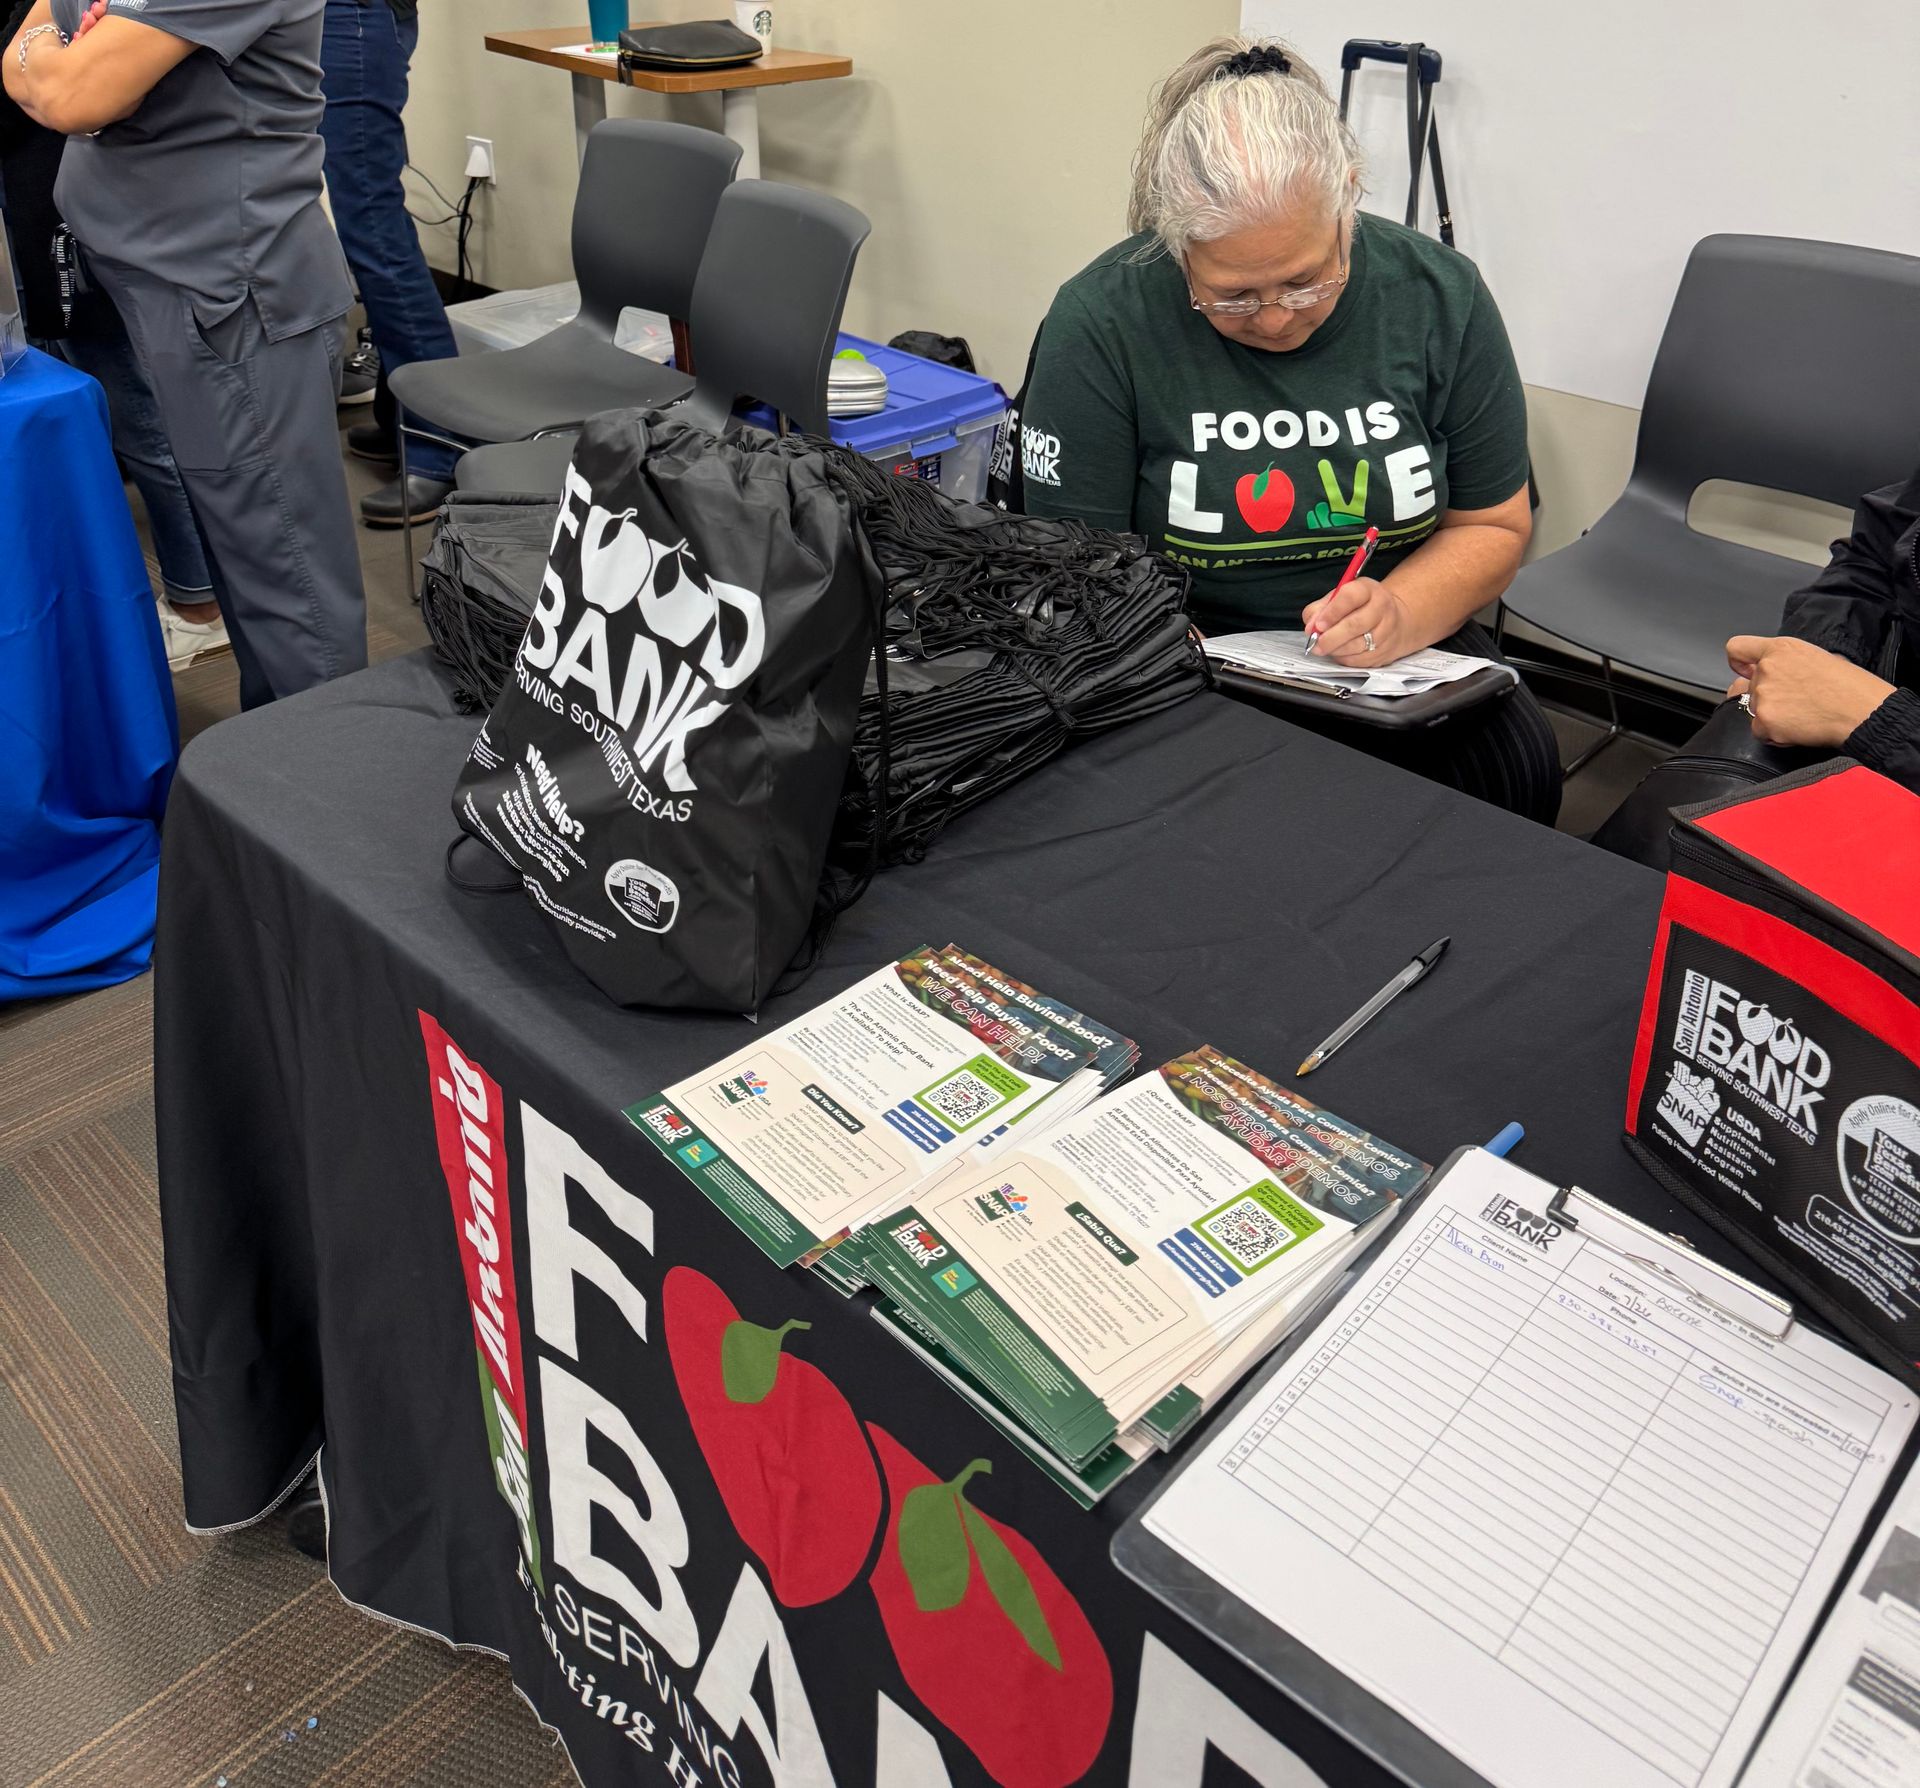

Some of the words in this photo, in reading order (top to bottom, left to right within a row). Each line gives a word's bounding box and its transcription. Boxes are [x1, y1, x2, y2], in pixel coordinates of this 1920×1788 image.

[1191, 409, 1340, 452] FOOD
[1344, 401, 1400, 446] IS
[1168, 444, 1436, 534] LOVE
[549, 461, 766, 690] FOOD
[1165, 550, 1208, 569] SAN
[520, 560, 733, 793] BANK
[570, 703, 634, 789] SOUTHWEST
[627, 775, 693, 822] TEXAS
[526, 743, 558, 795] Need
[542, 784, 585, 842] Help?
[547, 899, 579, 919] Nutrition
[579, 915, 617, 939] Assistance
[575, 922, 607, 943] provider.
[883, 982, 901, 998] What
[900, 995, 907, 1003] Is
[906, 1001, 931, 1019] SNAP?
[920, 976, 957, 1003] WE
[951, 999, 994, 1029] CAN
[987, 1024, 1047, 1064] HELP!
[923, 959, 960, 985] Need
[955, 981, 987, 1004] Help
[984, 1001, 1033, 1036] Buying
[1031, 1032, 1077, 1061] Food?
[948, 955, 986, 978] Need
[1066, 1020, 1114, 1049] Food?
[1681, 973, 1706, 1028] Antonio
[840, 1005, 848, 1013] Is
[846, 1008, 876, 1036] Available
[875, 1033, 885, 1043] To
[883, 1039, 903, 1057] Help!
[848, 1001, 862, 1013] The
[860, 1010, 874, 1024] San
[873, 1019, 900, 1043] Antonio
[899, 1041, 917, 1056] Food
[916, 1053, 935, 1069] Bank
[1676, 1027, 1695, 1055] San
[1706, 980, 1832, 1088] FOOD
[723, 1080, 751, 1101] SNAP
[1698, 1016, 1826, 1136] BANK
[807, 1087, 822, 1100] Did
[820, 1097, 836, 1111] You
[832, 1107, 860, 1131] Know?
[1163, 1101, 1173, 1111] Es
[1171, 1107, 1197, 1128] SNAP?
[1660, 1092, 1707, 1130] SNAP
[1695, 1053, 1733, 1086] SERVING
[1732, 1078, 1787, 1124] SOUTHWEST
[1785, 1116, 1817, 1147] TEXAS
[1848, 1108, 1869, 1129] Apply
[1867, 1102, 1897, 1117] Online
[646, 1115, 684, 1144] BANK
[660, 1106, 693, 1137] FOOD
[1189, 1076, 1278, 1142] NOSOTROS
[1272, 1139, 1362, 1206] PODEMOS
[1215, 1114, 1288, 1166] AYUDAR
[1257, 1084, 1292, 1107] Ayuda
[1290, 1100, 1316, 1120] Para
[1316, 1117, 1365, 1144] Comprar
[1363, 1142, 1413, 1170] Comida?
[1713, 1116, 1777, 1167] Supplemental
[1726, 1106, 1763, 1142] USDA
[1105, 1110, 1131, 1133] Antonio
[1129, 1129, 1145, 1144] Está
[1142, 1141, 1176, 1171] Disponible
[1175, 1167, 1192, 1183] Para
[1190, 1179, 1217, 1204] Ayudar!
[1121, 1113, 1142, 1131] Banco
[1139, 1127, 1150, 1137] De
[1149, 1136, 1182, 1164] Alimentos
[1179, 1161, 1191, 1171] De
[1189, 1168, 1204, 1182] San
[1237, 1096, 1268, 1122] Ayuda
[1266, 1117, 1290, 1136] Para
[1288, 1133, 1333, 1165] Comprar
[1330, 1164, 1377, 1198] Comida?
[1303, 1123, 1401, 1181] PODEMOS
[1703, 1147, 1744, 1179] Program
[1706, 1137, 1758, 1177] Assistance
[1709, 1126, 1752, 1160] Nutrition
[1874, 1141, 1913, 1175] Texas
[1877, 1131, 1909, 1160] Your
[1651, 1122, 1673, 1146] Putting
[1673, 1140, 1698, 1164] Healthy
[1697, 1159, 1717, 1177] Food
[1717, 1172, 1742, 1196] Within
[1741, 1191, 1764, 1212] Reach
[1868, 1175, 1892, 1195] TEXAS
[1870, 1164, 1896, 1182] .com
[979, 1192, 1011, 1218] SNAP
[1017, 1211, 1034, 1227] USDA
[1266, 1194, 1279, 1205] Con
[1501, 1199, 1562, 1239] FOOD
[1861, 1193, 1914, 1233] COMMISSION
[438, 1044, 516, 1396] Antonio
[1075, 1212, 1104, 1237] ¿Sabía
[1492, 1210, 1556, 1251] BANK
[898, 1230, 939, 1268] BANK
[910, 1223, 948, 1259] FOOD
[1481, 1235, 1506, 1252] Client
[1505, 1248, 1528, 1263] Name
[1598, 1285, 1621, 1302] Date:
[1608, 1272, 1648, 1299] Location:
[1341, 1327, 1352, 1337] 10
[1609, 1305, 1638, 1326] Phone
[1686, 1295, 1716, 1316] Client
[1713, 1310, 1733, 1328] Sign
[1738, 1323, 1750, 1334] In
[1749, 1328, 1775, 1350] Sheet
[1320, 1352, 1331, 1361] 12
[1331, 1340, 1342, 1349] 11
[1698, 1373, 1744, 1409] Snap
[1711, 1365, 1746, 1388] Service
[1745, 1385, 1765, 1400] you
[1764, 1396, 1781, 1407] are
[1781, 1404, 1830, 1435] interested
[1830, 1430, 1843, 1442] in:
[494, 1387, 534, 1562] San
[554, 1583, 742, 1788] SERVING
